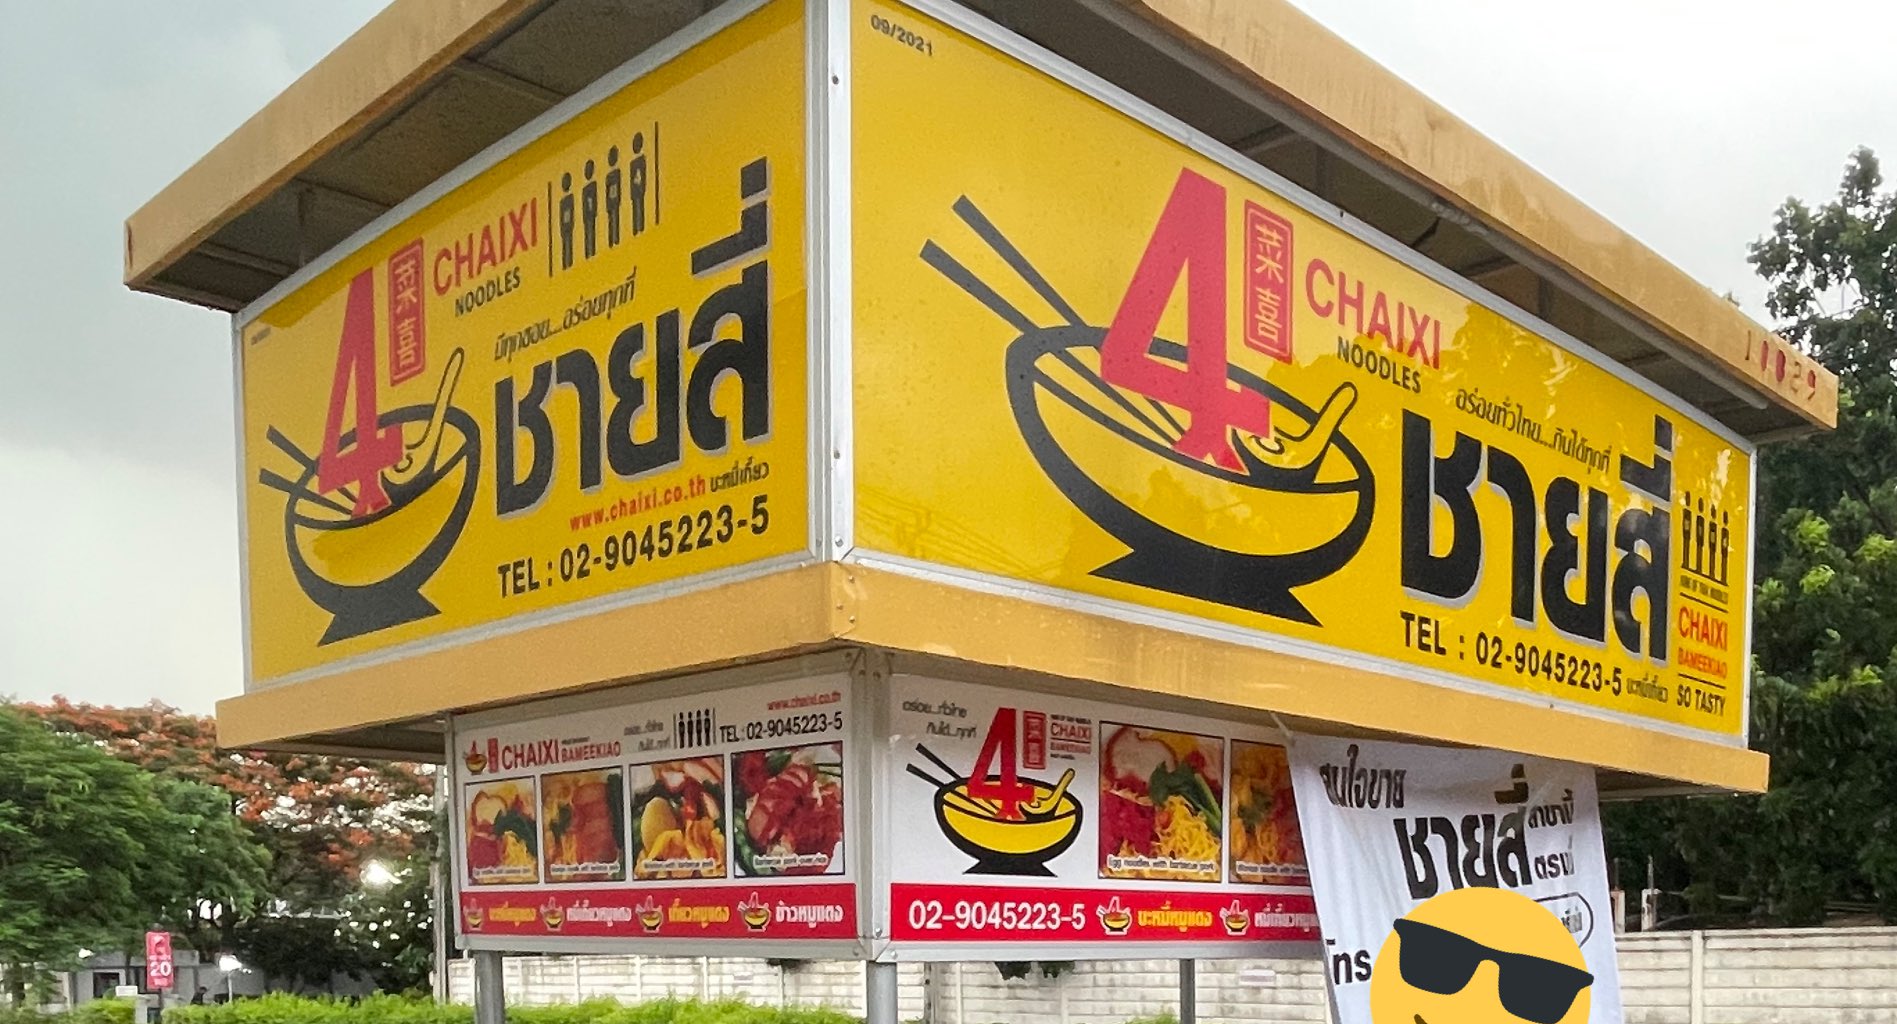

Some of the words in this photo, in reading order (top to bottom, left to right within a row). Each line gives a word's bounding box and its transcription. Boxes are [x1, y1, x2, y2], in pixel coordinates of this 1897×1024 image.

[870, 14, 933, 57] 09/2021
[433, 196, 538, 296] CHAIXI
[454, 266, 521, 318] NOODLES
[1305, 257, 1441, 370] CHAIXI
[494, 156, 770, 517] ชายสี่
[1336, 335, 1421, 394] NOODLES
[569, 474, 706, 532] www.chaixi.co.th
[497, 556, 541, 599] TEL
[559, 493, 770, 582] 02-9045223-5
[1400, 413, 1673, 664] ชายสี่
[1399, 609, 1447, 656] TEL
[1475, 631, 1622, 697] 02-9045223-5
[1678, 606, 1728, 651] CHAIXI
[746, 711, 844, 741] 02-9045223-5
[1677, 683, 1691, 708] SO
[1694, 686, 1727, 717] TASTY
[501, 737, 560, 770] CHAIXI
[1392, 763, 1533, 901] ชายสี่
[908, 899, 1086, 930] 02-9045223-5
[150, 961, 172, 977] 20
